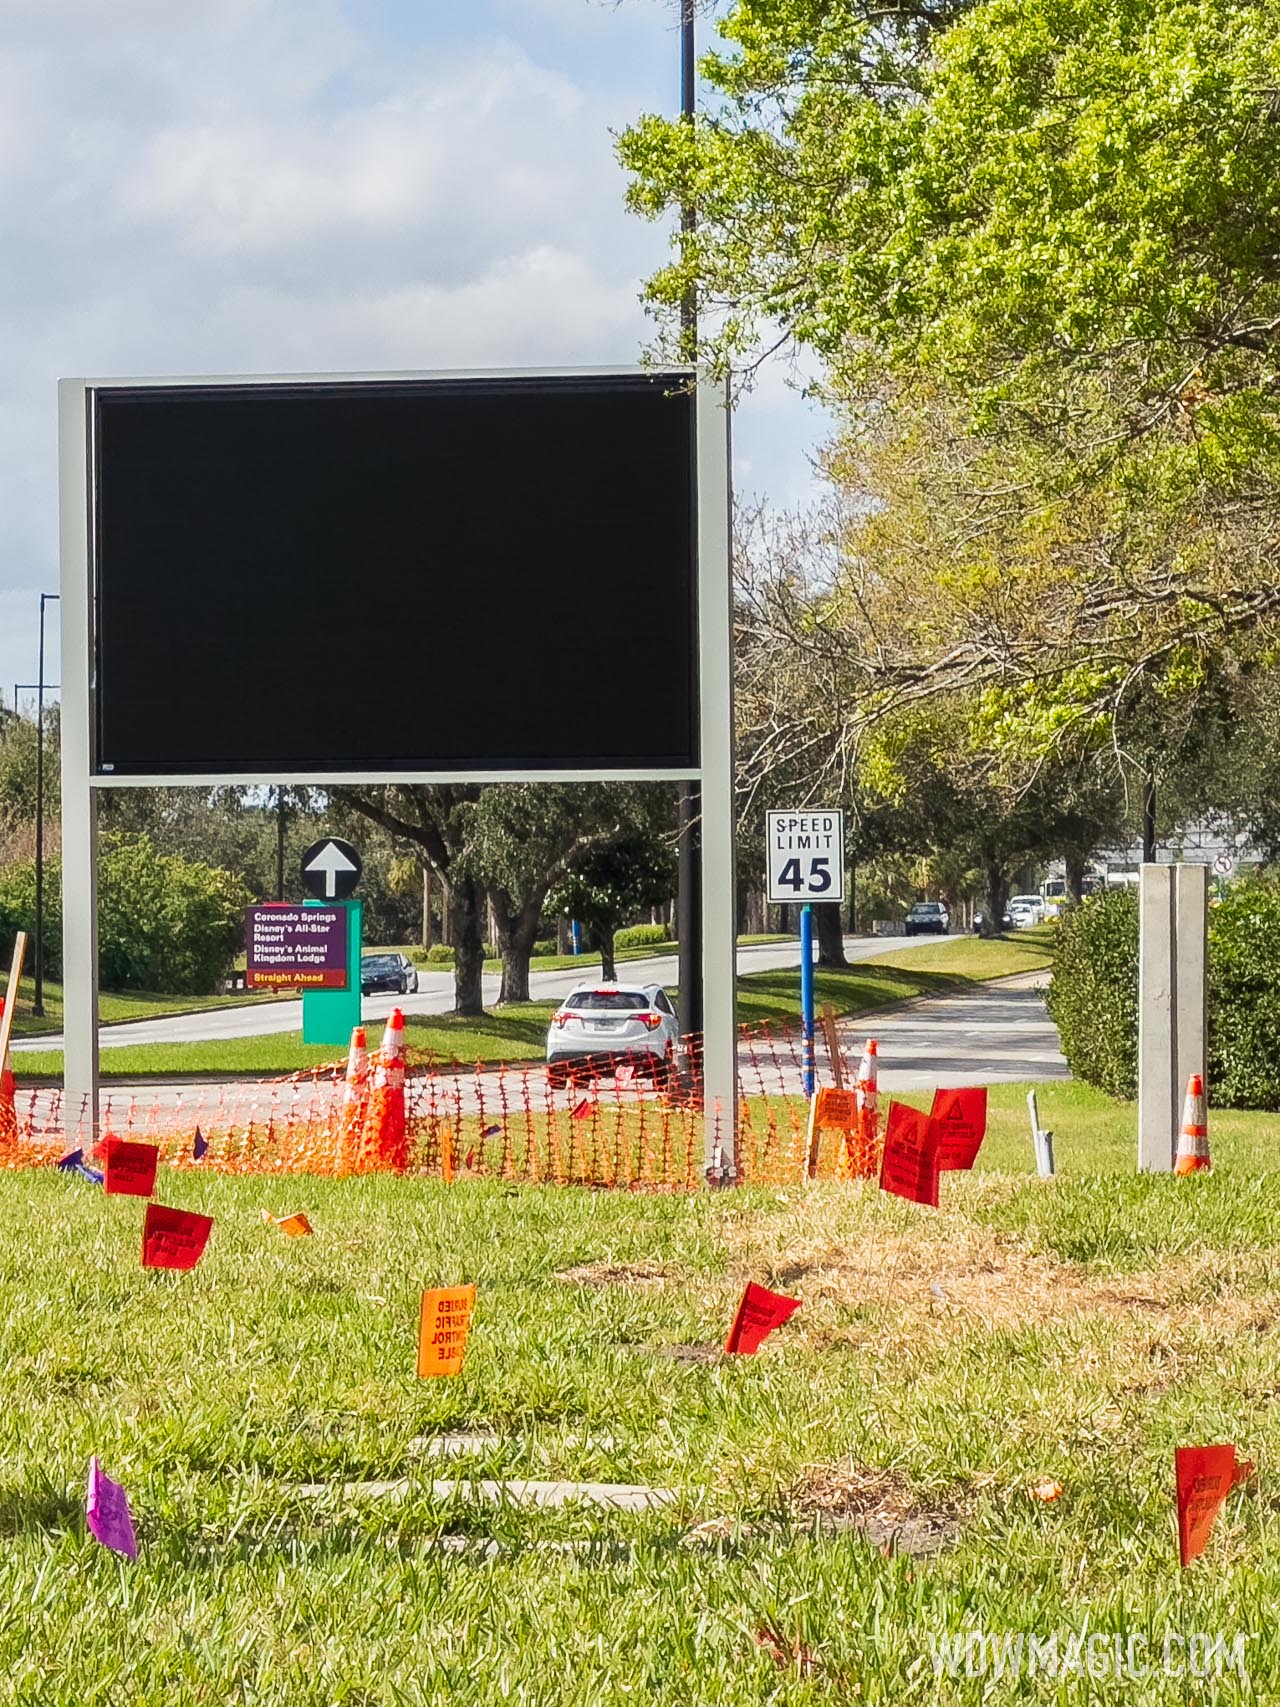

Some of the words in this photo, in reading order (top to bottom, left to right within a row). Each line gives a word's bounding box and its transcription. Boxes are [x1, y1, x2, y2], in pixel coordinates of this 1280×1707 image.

[776, 818, 832, 832] SPEED
[777, 835, 832, 849] LIMIT
[778, 857, 832, 893] 45
[254, 912, 299, 921] Coronado
[301, 912, 336, 923] Springs
[253, 924, 293, 933] Disney's
[295, 923, 330, 933] All-Star
[253, 933, 284, 942] Resort
[253, 944, 293, 954] Disney's
[295, 944, 328, 953] Animal
[253, 954, 295, 964] Kingdom
[297, 954, 326, 964] Lodge
[254, 973, 292, 983] Straight
[294, 973, 324, 982] Ahead
